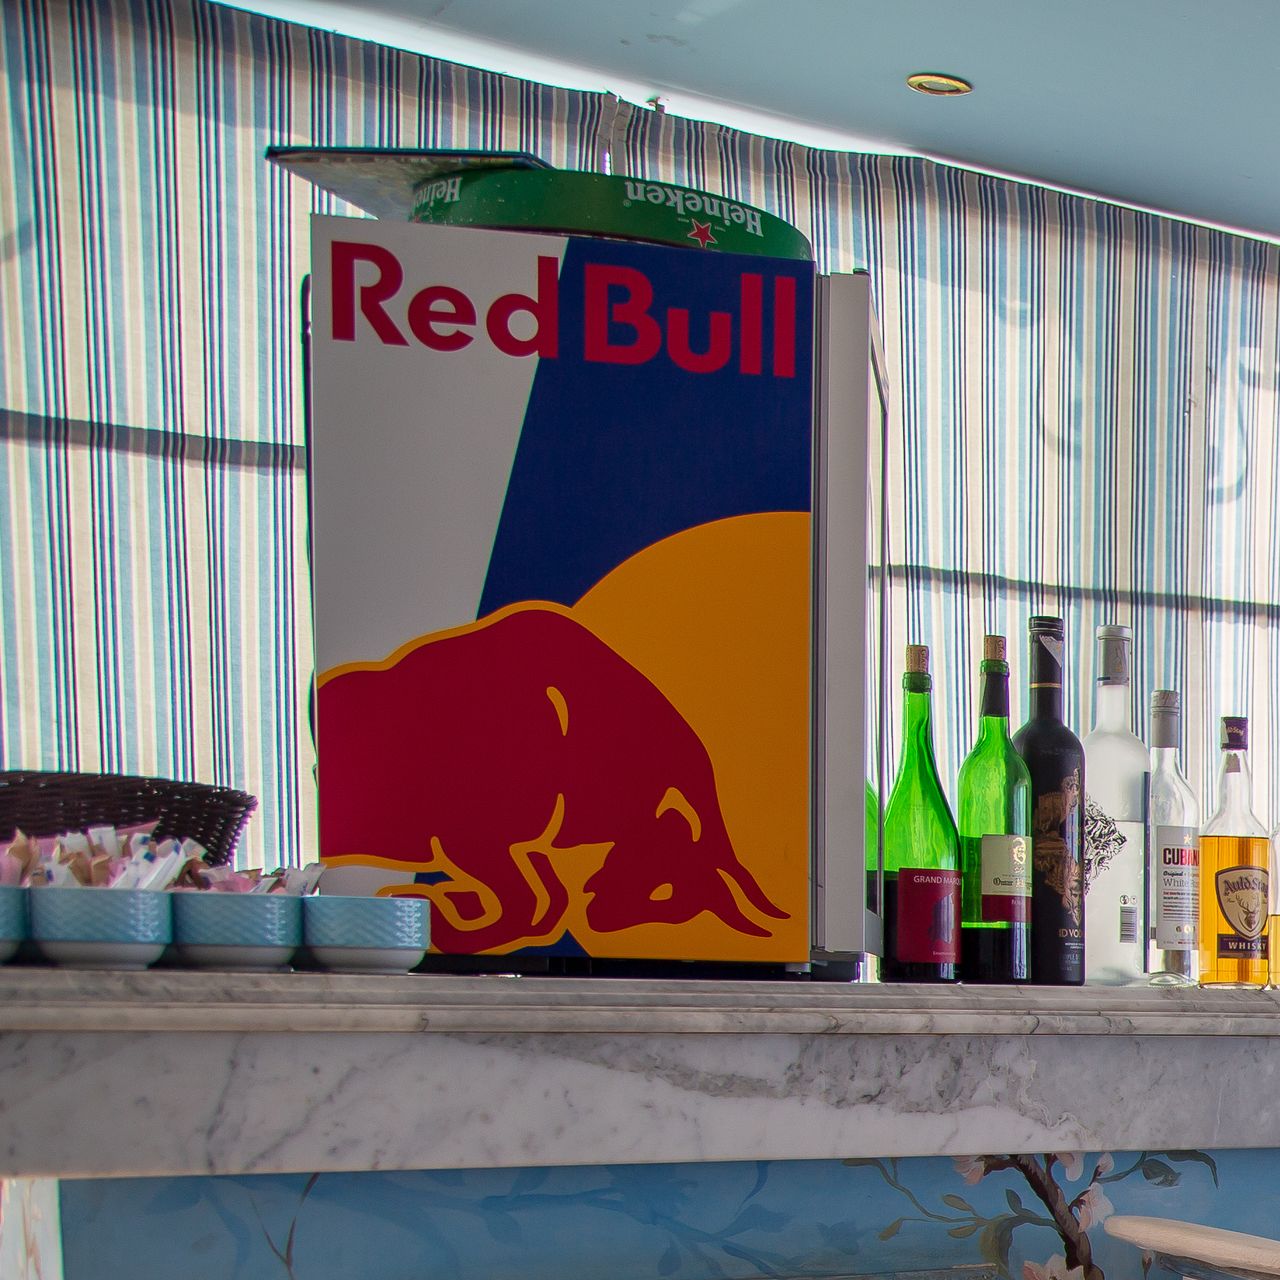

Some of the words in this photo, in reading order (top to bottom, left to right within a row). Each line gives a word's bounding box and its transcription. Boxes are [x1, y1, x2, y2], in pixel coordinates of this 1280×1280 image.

[625, 181, 763, 238] Heineken
[331, 240, 559, 359] Red
[584, 262, 796, 379] Bull
[913, 875, 942, 884] GRAND
[1228, 941, 1266, 950] WHISKY
